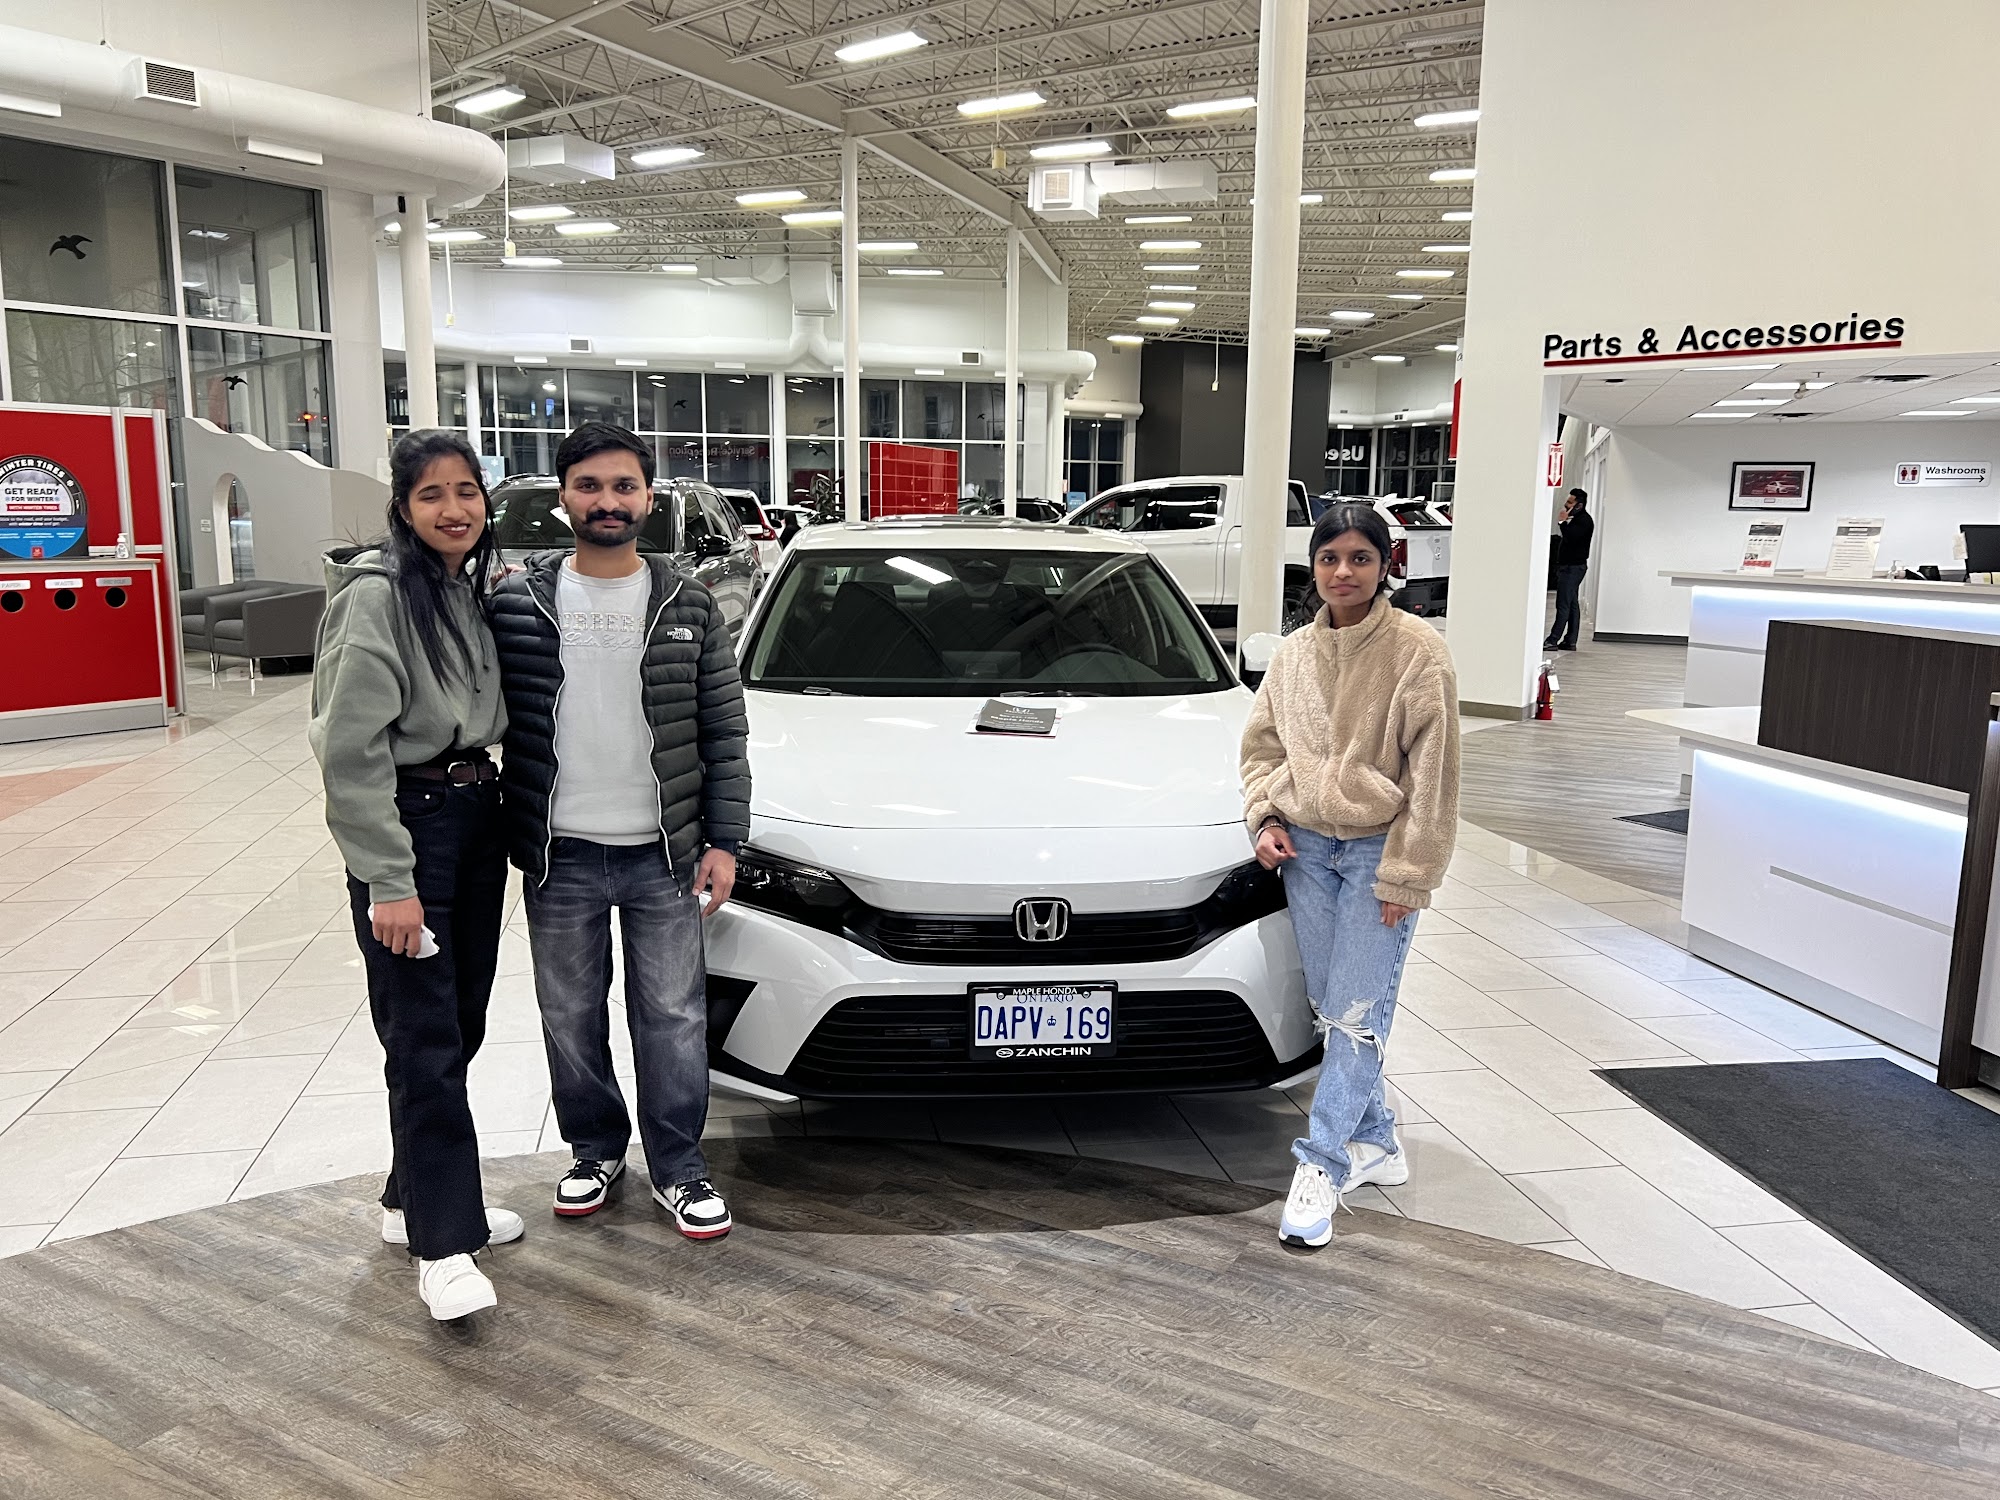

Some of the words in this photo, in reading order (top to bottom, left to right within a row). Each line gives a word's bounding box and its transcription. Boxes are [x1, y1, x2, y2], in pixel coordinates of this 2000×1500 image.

[1544, 333, 1622, 359] Parts
[1637, 328, 1659, 354] &
[1676, 312, 1905, 351] Accessories
[36, 460, 66, 478] TIRES
[1925, 466, 1986, 474] Washrooms
[4, 487, 24, 495] GET
[1042, 987, 1078, 995] HONDA
[1016, 994, 1074, 1004] ONTARIO
[977, 1005, 1043, 1040] DAPV
[1063, 1006, 1110, 1039] 169
[1015, 1047, 1091, 1057] ZANCHIN
